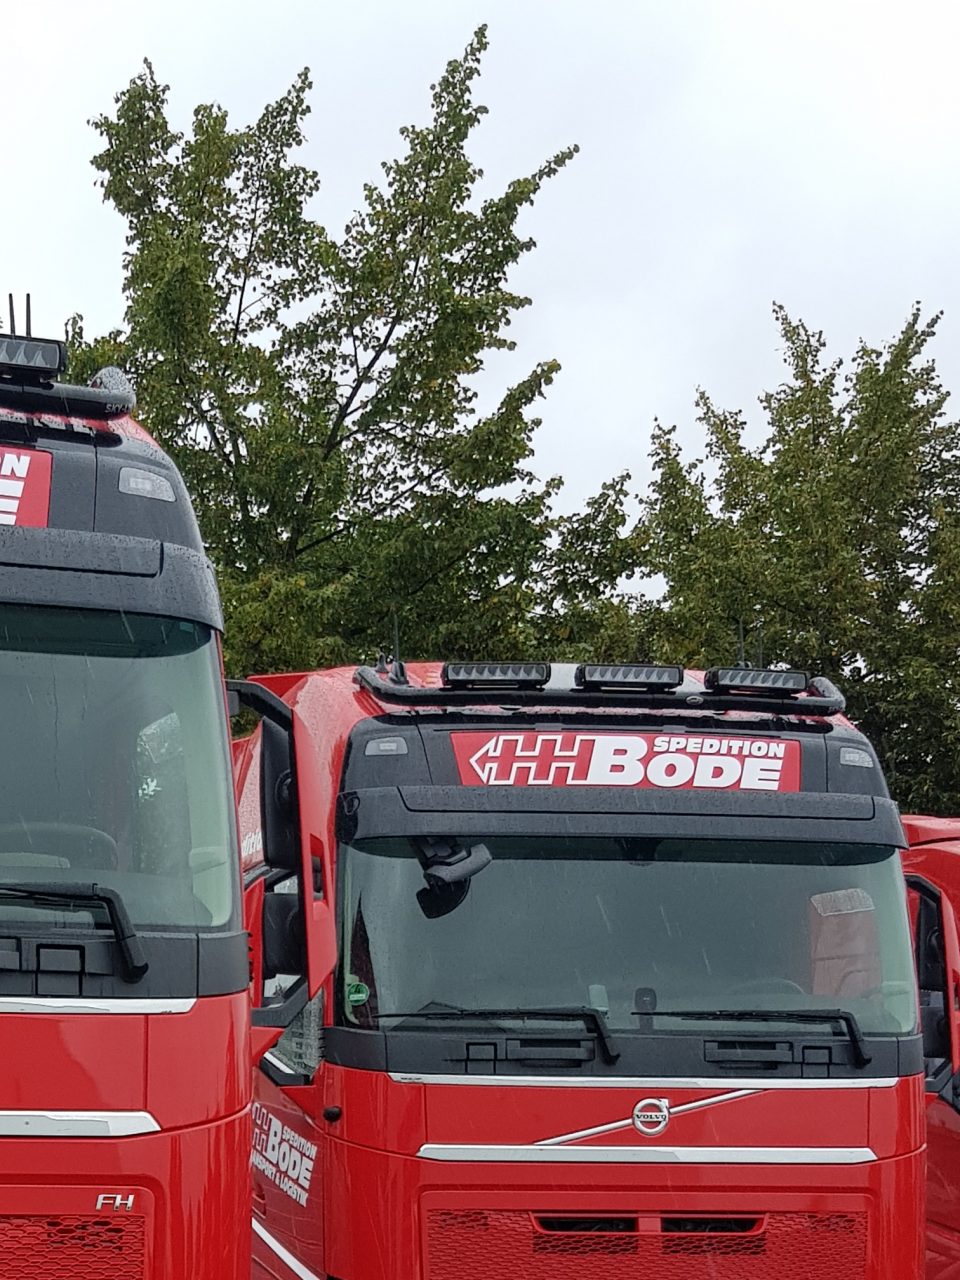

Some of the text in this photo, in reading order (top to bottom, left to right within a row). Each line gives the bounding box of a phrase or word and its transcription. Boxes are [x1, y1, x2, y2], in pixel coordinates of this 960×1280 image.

[587, 736, 784, 791] BODE
[653, 736, 786, 758] SPEDITION
[265, 1113, 314, 1190] BODE
[282, 1125, 318, 1159] SPEDITION
[95, 1194, 135, 1211] FH
